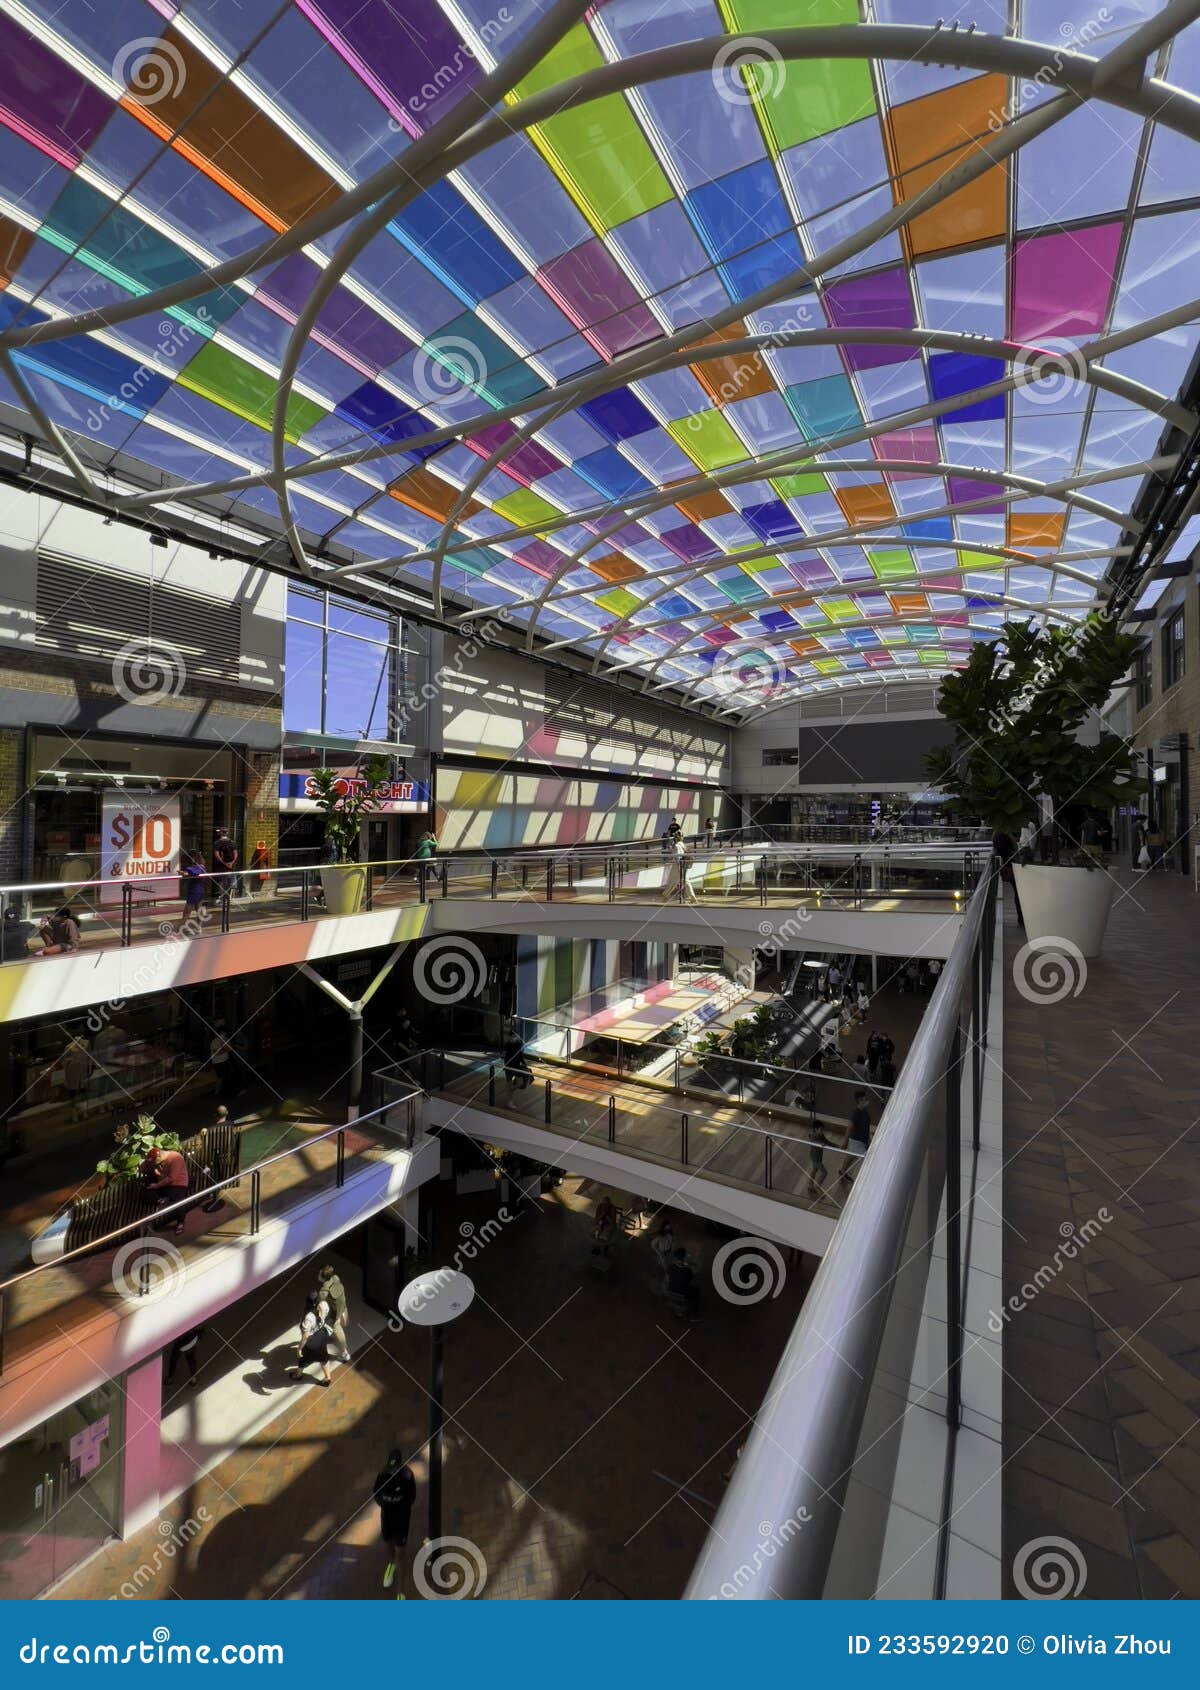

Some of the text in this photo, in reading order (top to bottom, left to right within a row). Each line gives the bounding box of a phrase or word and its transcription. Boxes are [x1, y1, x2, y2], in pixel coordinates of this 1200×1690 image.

[304, 776, 413, 799] SOTLGHT
[111, 813, 171, 859] $10
[110, 861, 171, 876] & UNDER
